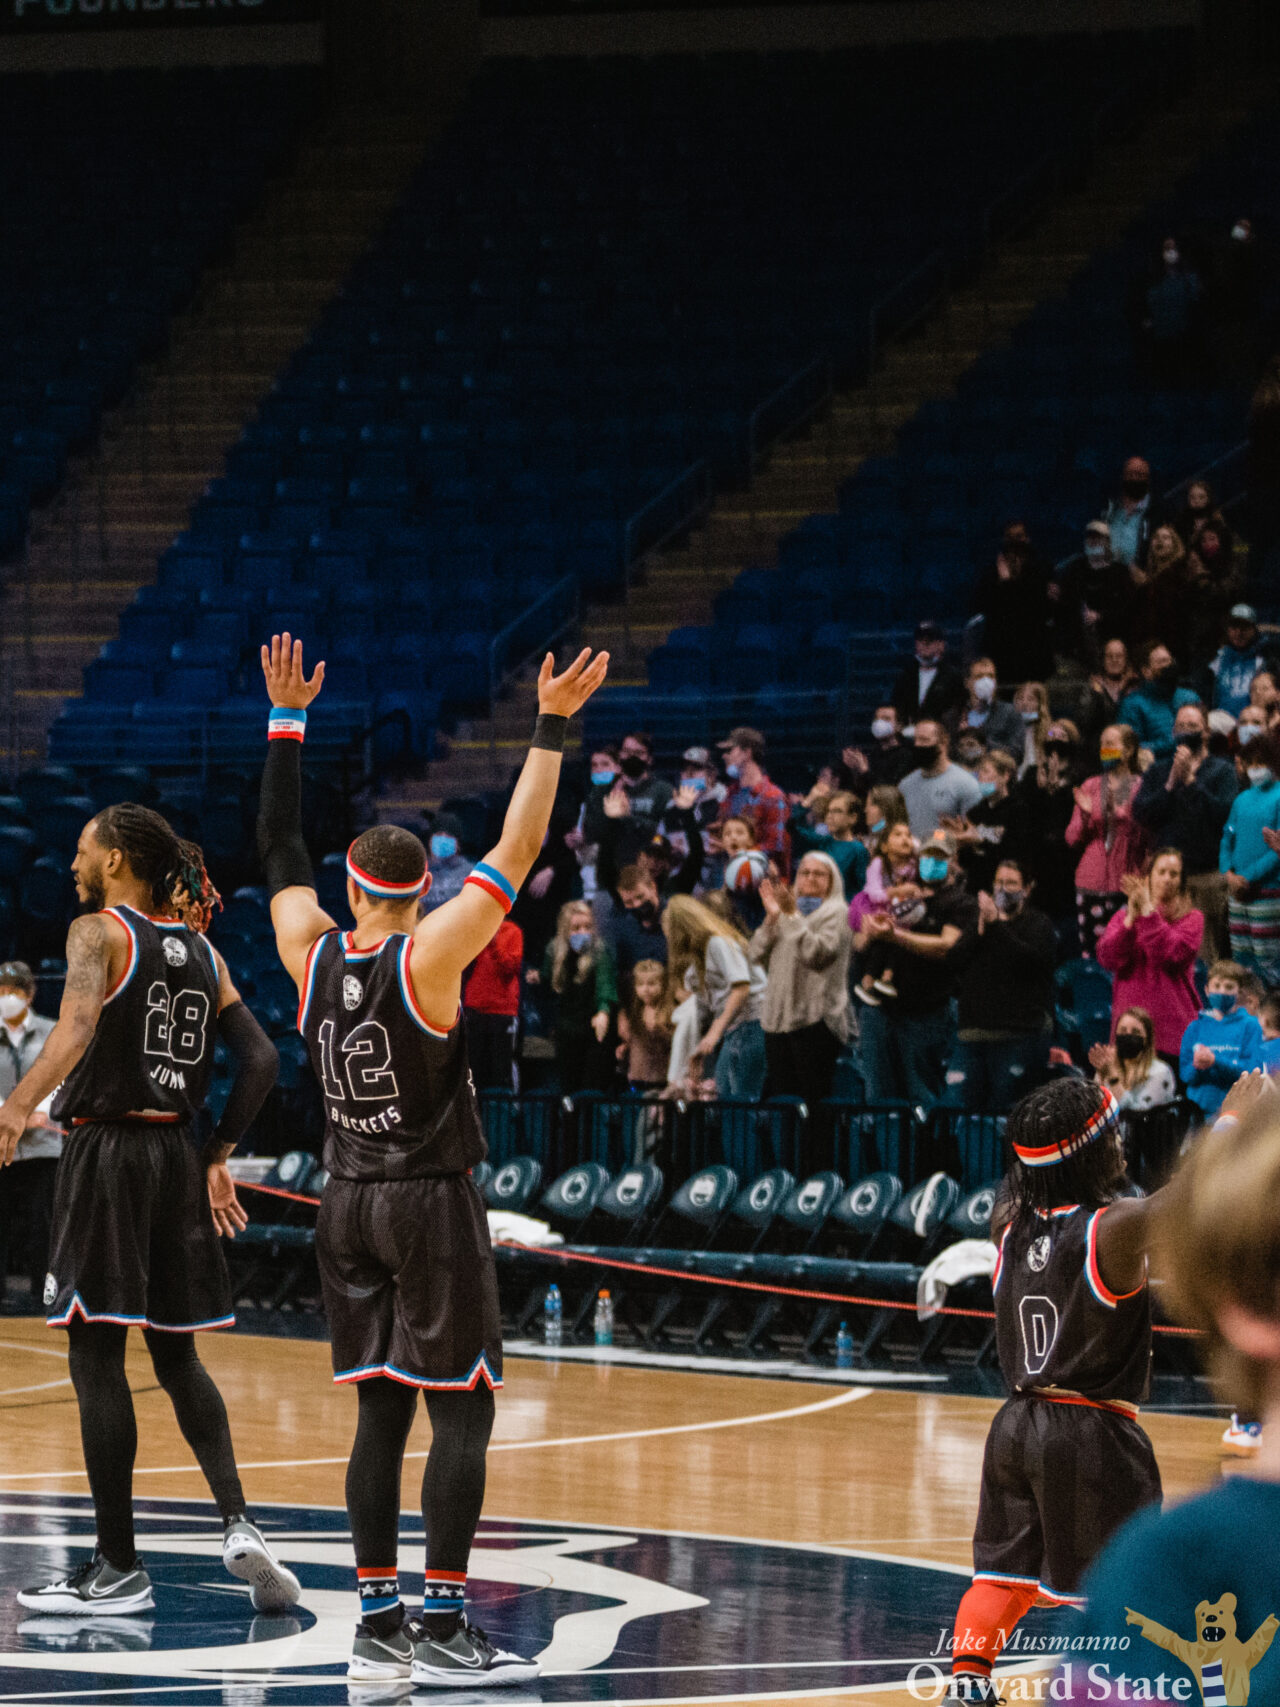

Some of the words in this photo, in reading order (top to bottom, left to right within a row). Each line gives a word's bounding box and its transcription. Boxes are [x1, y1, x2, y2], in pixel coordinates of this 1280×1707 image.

[143, 980, 211, 1065] 28
[317, 1018, 400, 1101] 12
[331, 1105, 402, 1134] BUCKETS
